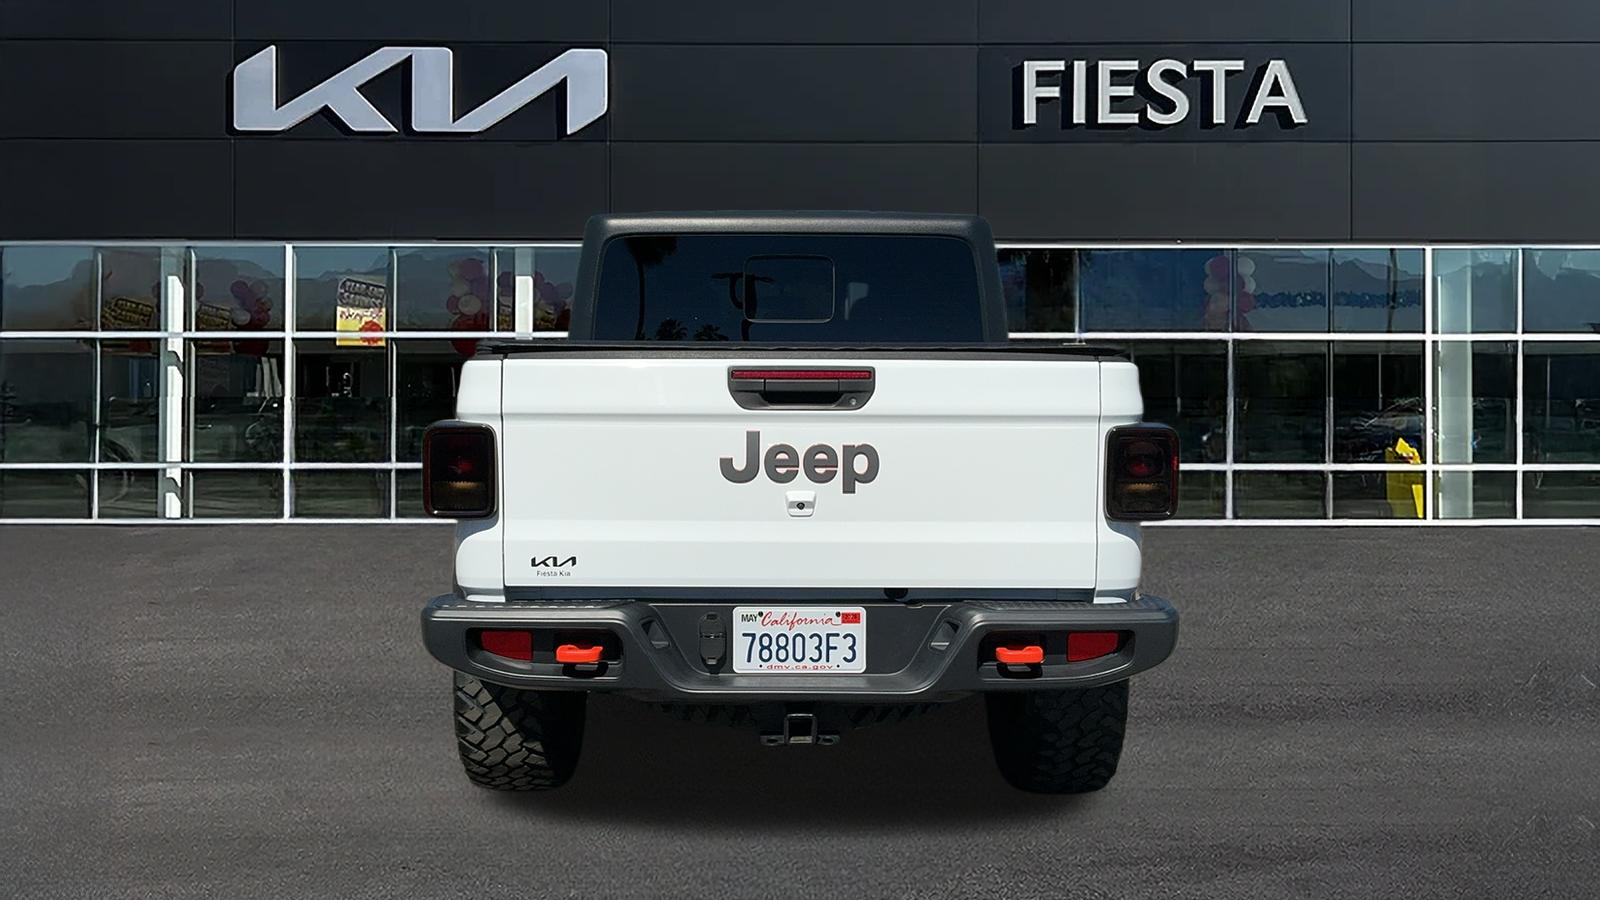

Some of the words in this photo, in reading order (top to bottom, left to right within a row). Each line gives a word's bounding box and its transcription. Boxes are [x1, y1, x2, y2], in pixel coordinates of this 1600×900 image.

[1022, 58, 1309, 126] FIESTA
[719, 430, 880, 494] Jeep
[741, 614, 758, 623] MAY
[761, 611, 842, 631] California
[742, 632, 857, 663] 78803F3
